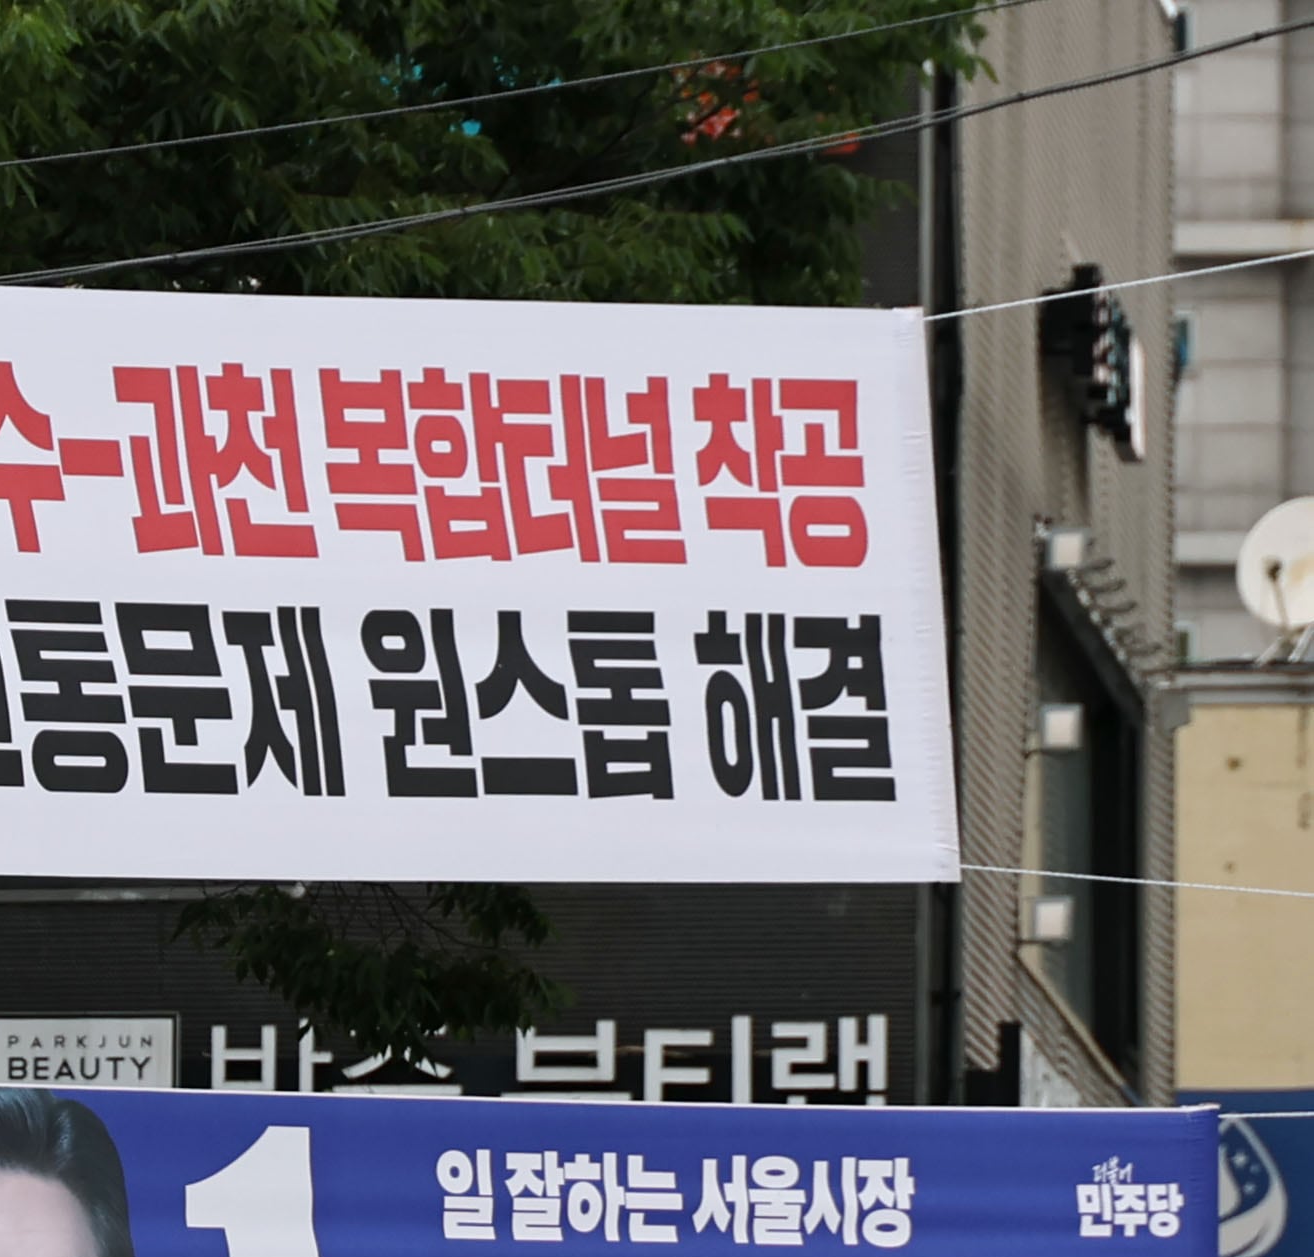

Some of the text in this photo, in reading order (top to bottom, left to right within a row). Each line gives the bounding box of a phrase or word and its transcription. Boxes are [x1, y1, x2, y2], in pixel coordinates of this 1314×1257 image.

[319, 367, 688, 565] 복합터널
[692, 372, 869, 569] 착공
[360, 608, 675, 800] 원스톱
[694, 610, 898, 802] 해결
[7, 1034, 154, 1048] PARKJUN
[7, 1056, 152, 1080] BEAUTY
[436, 1149, 915, 1248] 일 잘하는 서울시장
[1075, 1183, 1185, 1237] 민주당
